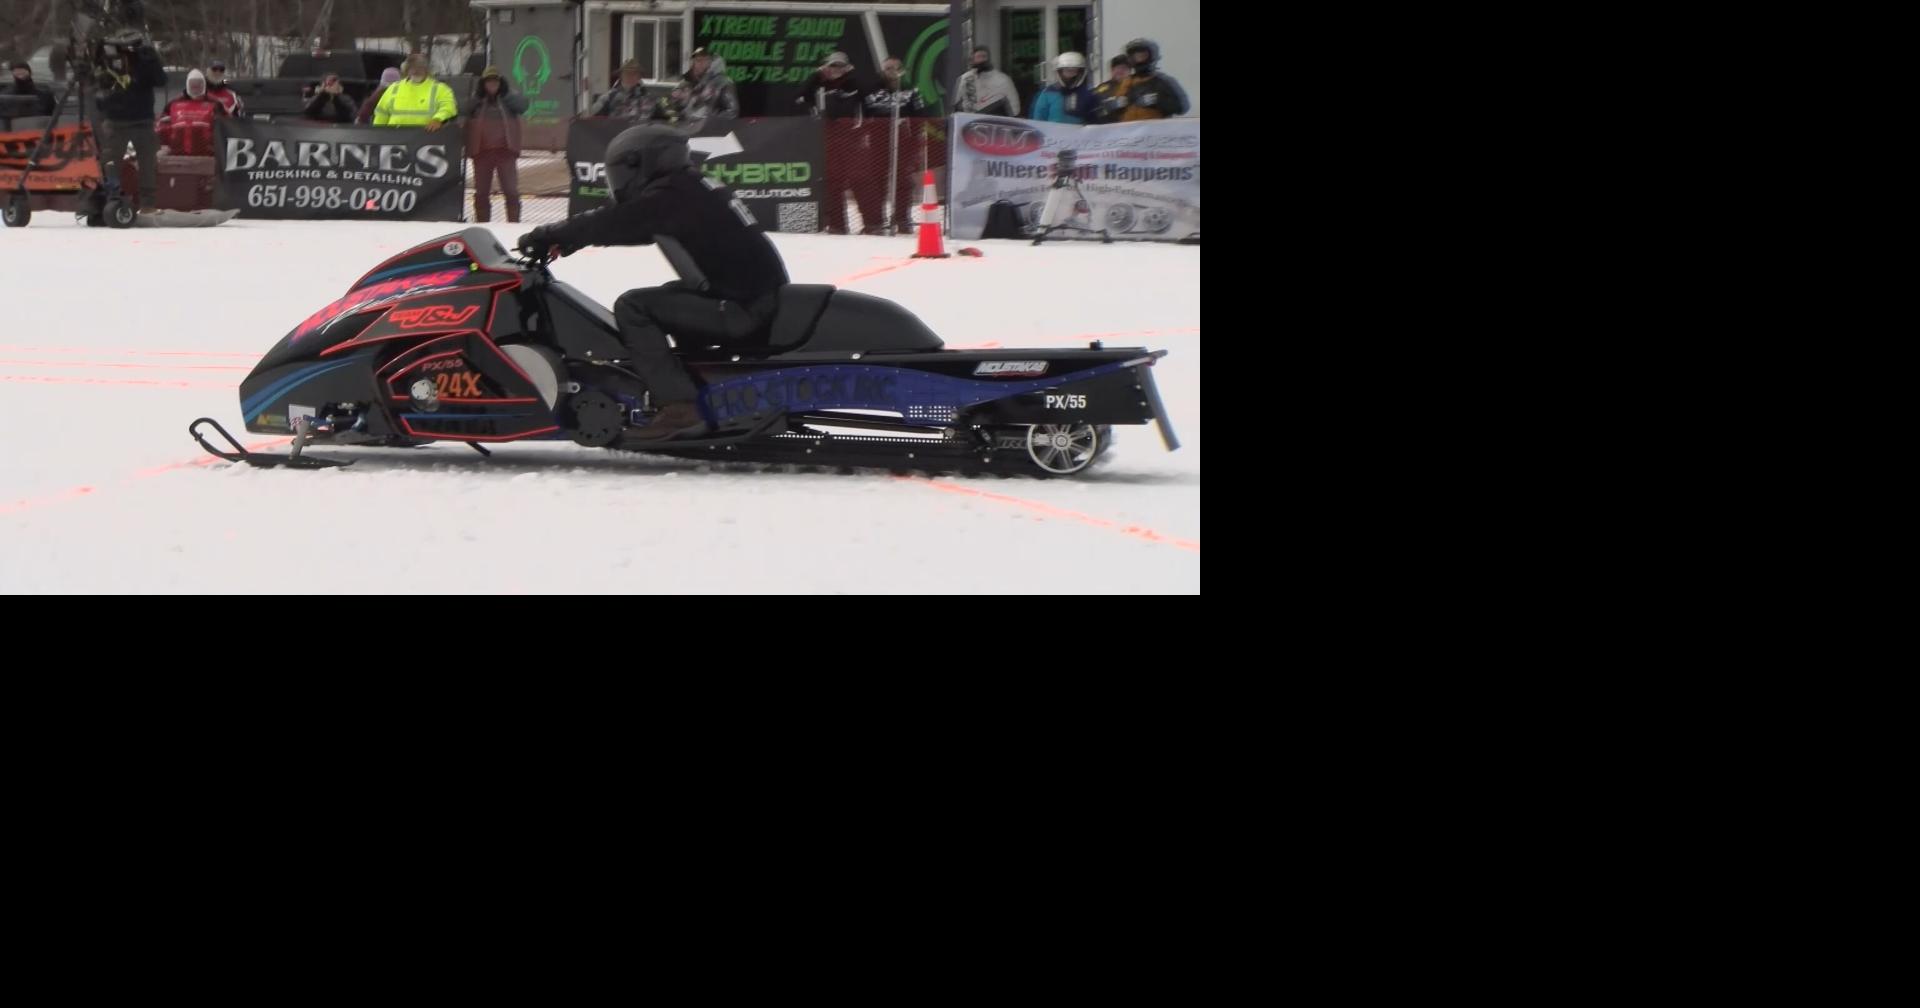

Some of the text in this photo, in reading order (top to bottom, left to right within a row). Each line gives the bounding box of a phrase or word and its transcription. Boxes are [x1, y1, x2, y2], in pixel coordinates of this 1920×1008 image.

[699, 15, 846, 36] XTREME SOUND
[708, 40, 785, 61] MOBILE
[225, 137, 449, 178] BARNES
[248, 170, 423, 187] TRUCKING & DETAILING
[701, 162, 811, 183] HYBRID
[247, 184, 417, 213] 651-998-0200
[734, 188, 811, 199] SOLUTIONS
[435, 371, 482, 397] 24X
[1045, 394, 1087, 410] PX/55
